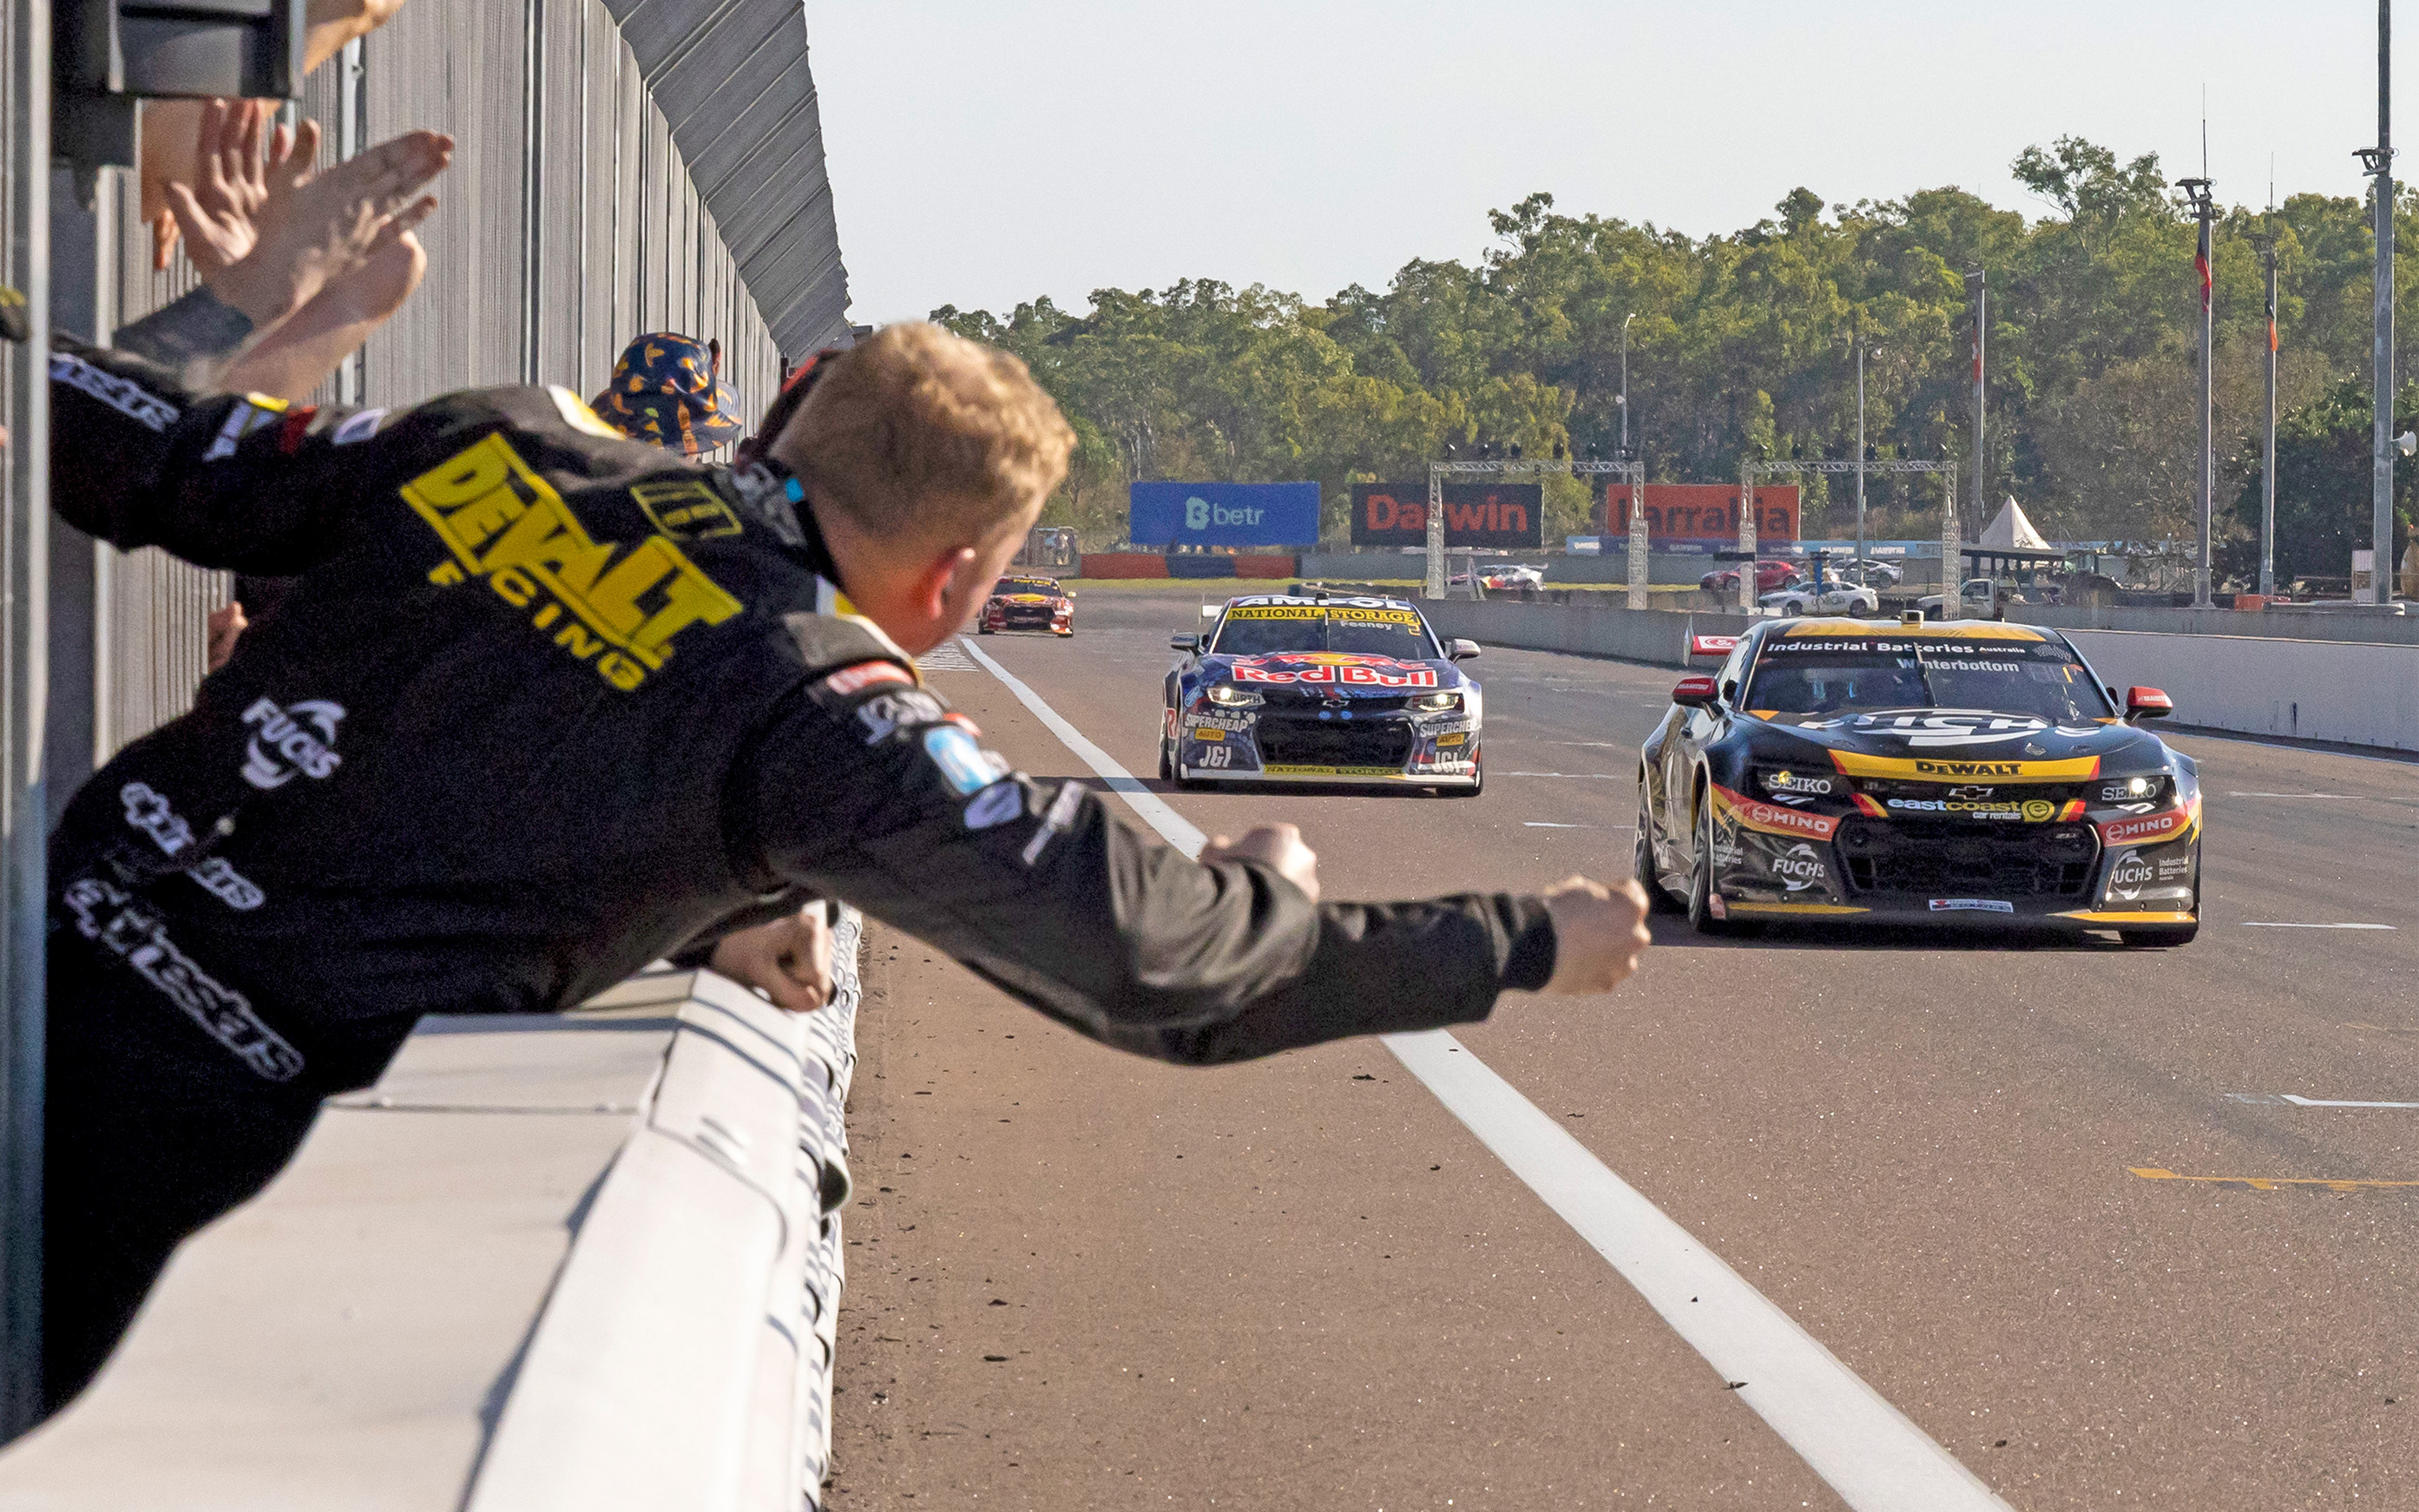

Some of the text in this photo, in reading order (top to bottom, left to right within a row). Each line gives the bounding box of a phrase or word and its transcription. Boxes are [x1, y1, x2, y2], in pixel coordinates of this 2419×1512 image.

[1213, 503, 1264, 525] betr
[1366, 494, 1528, 531] Dawin
[1232, 608, 1414, 622] NATIONAL STORAGE
[1767, 641, 1868, 652] Industrial
[1877, 642, 1975, 654] Batteries
[1896, 657, 2020, 673] Wnterbottom
[1233, 665, 1439, 687] Red Bull
[1184, 713, 1249, 733] SUPERCHEAP
[1438, 734, 1463, 743] AUTO
[1266, 765, 1336, 773] NATIONAL
[1768, 773, 1831, 793] SEIKO
[1773, 812, 1830, 832] HINO
[1989, 811, 2021, 819] rentals
[2126, 817, 2172, 835] HINO
[1772, 858, 1824, 878] FUCHS
